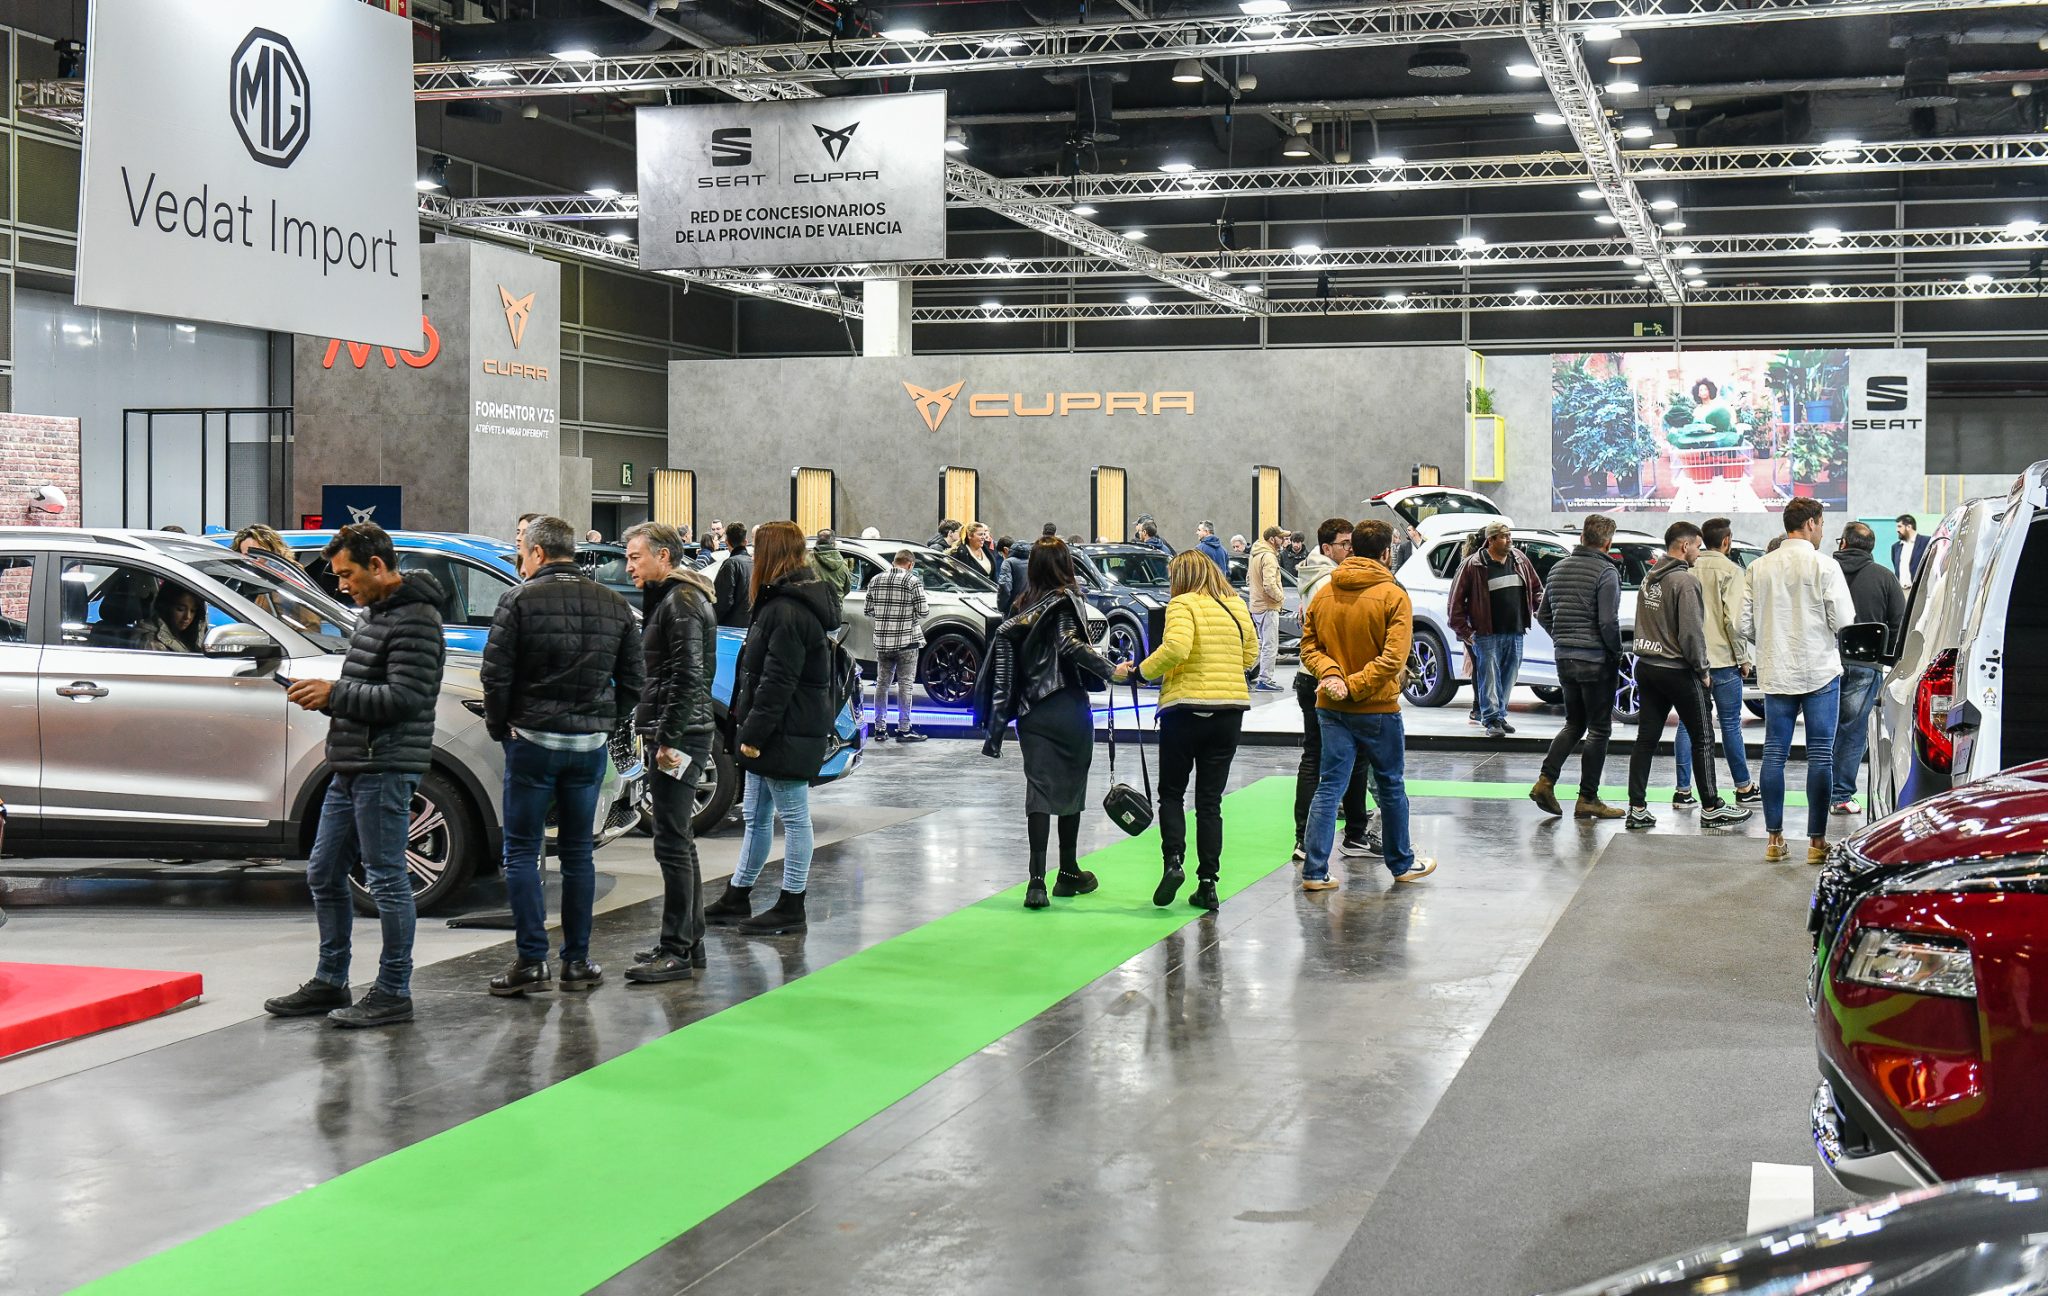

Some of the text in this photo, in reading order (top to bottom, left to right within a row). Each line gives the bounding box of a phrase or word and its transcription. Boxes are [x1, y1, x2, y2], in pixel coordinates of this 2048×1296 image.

[240, 44, 302, 152] MG
[698, 174, 767, 188] SEAT
[793, 170, 879, 184] CUPRA
[121, 166, 399, 277] Vedat Import
[690, 202, 886, 224] RED DE CONCESIONARIOS
[675, 221, 902, 243] DE LA PROVINCIA DE VALENCIA
[483, 359, 549, 381] CUPRA
[475, 400, 555, 424] FORMENTOR VZ5
[968, 391, 1195, 418] CUPRA
[1852, 419, 1922, 430] SEAT
